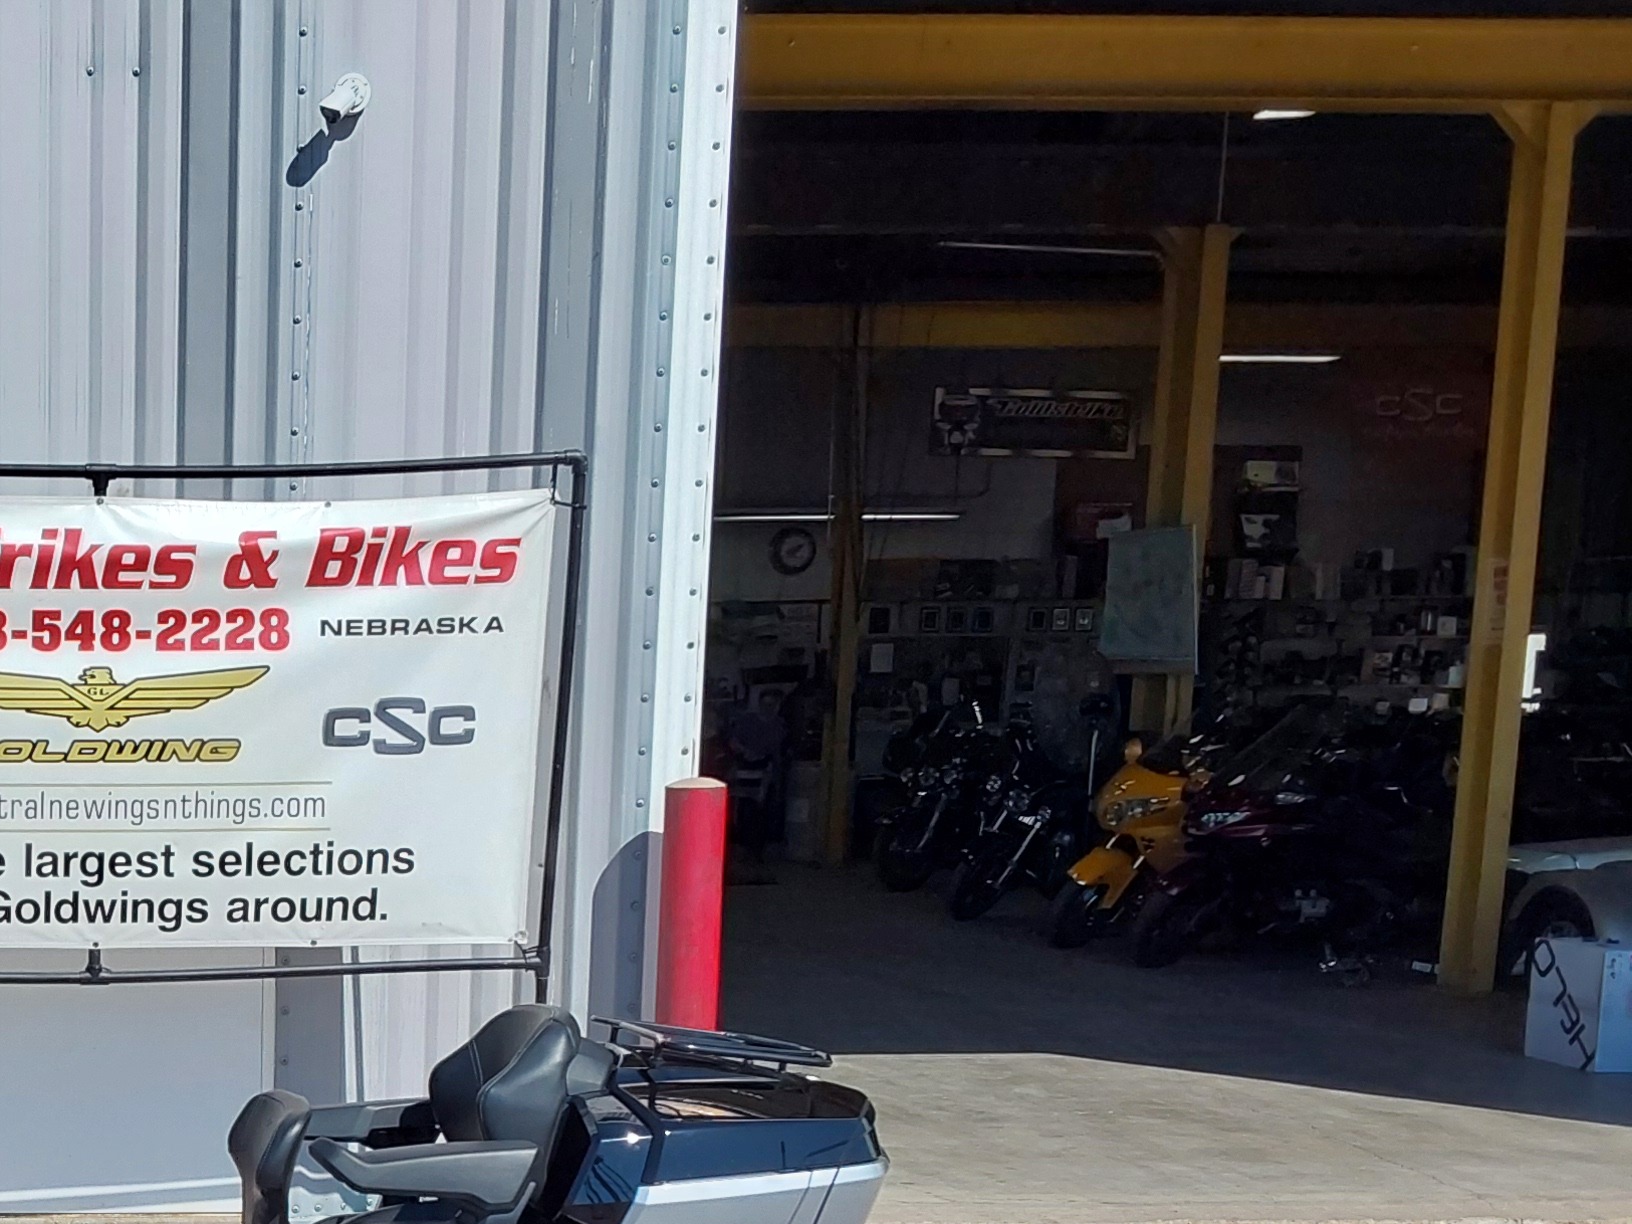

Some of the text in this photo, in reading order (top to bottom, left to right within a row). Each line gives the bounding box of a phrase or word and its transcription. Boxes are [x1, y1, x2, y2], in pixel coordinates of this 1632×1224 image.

[223, 530, 278, 590] &
[305, 525, 522, 588] Bikes
[319, 615, 505, 637] NEBRASKA
[86, 686, 110, 697] GL
[24, 842, 175, 887] largest
[191, 840, 415, 877] selections
[226, 887, 389, 923] around.
